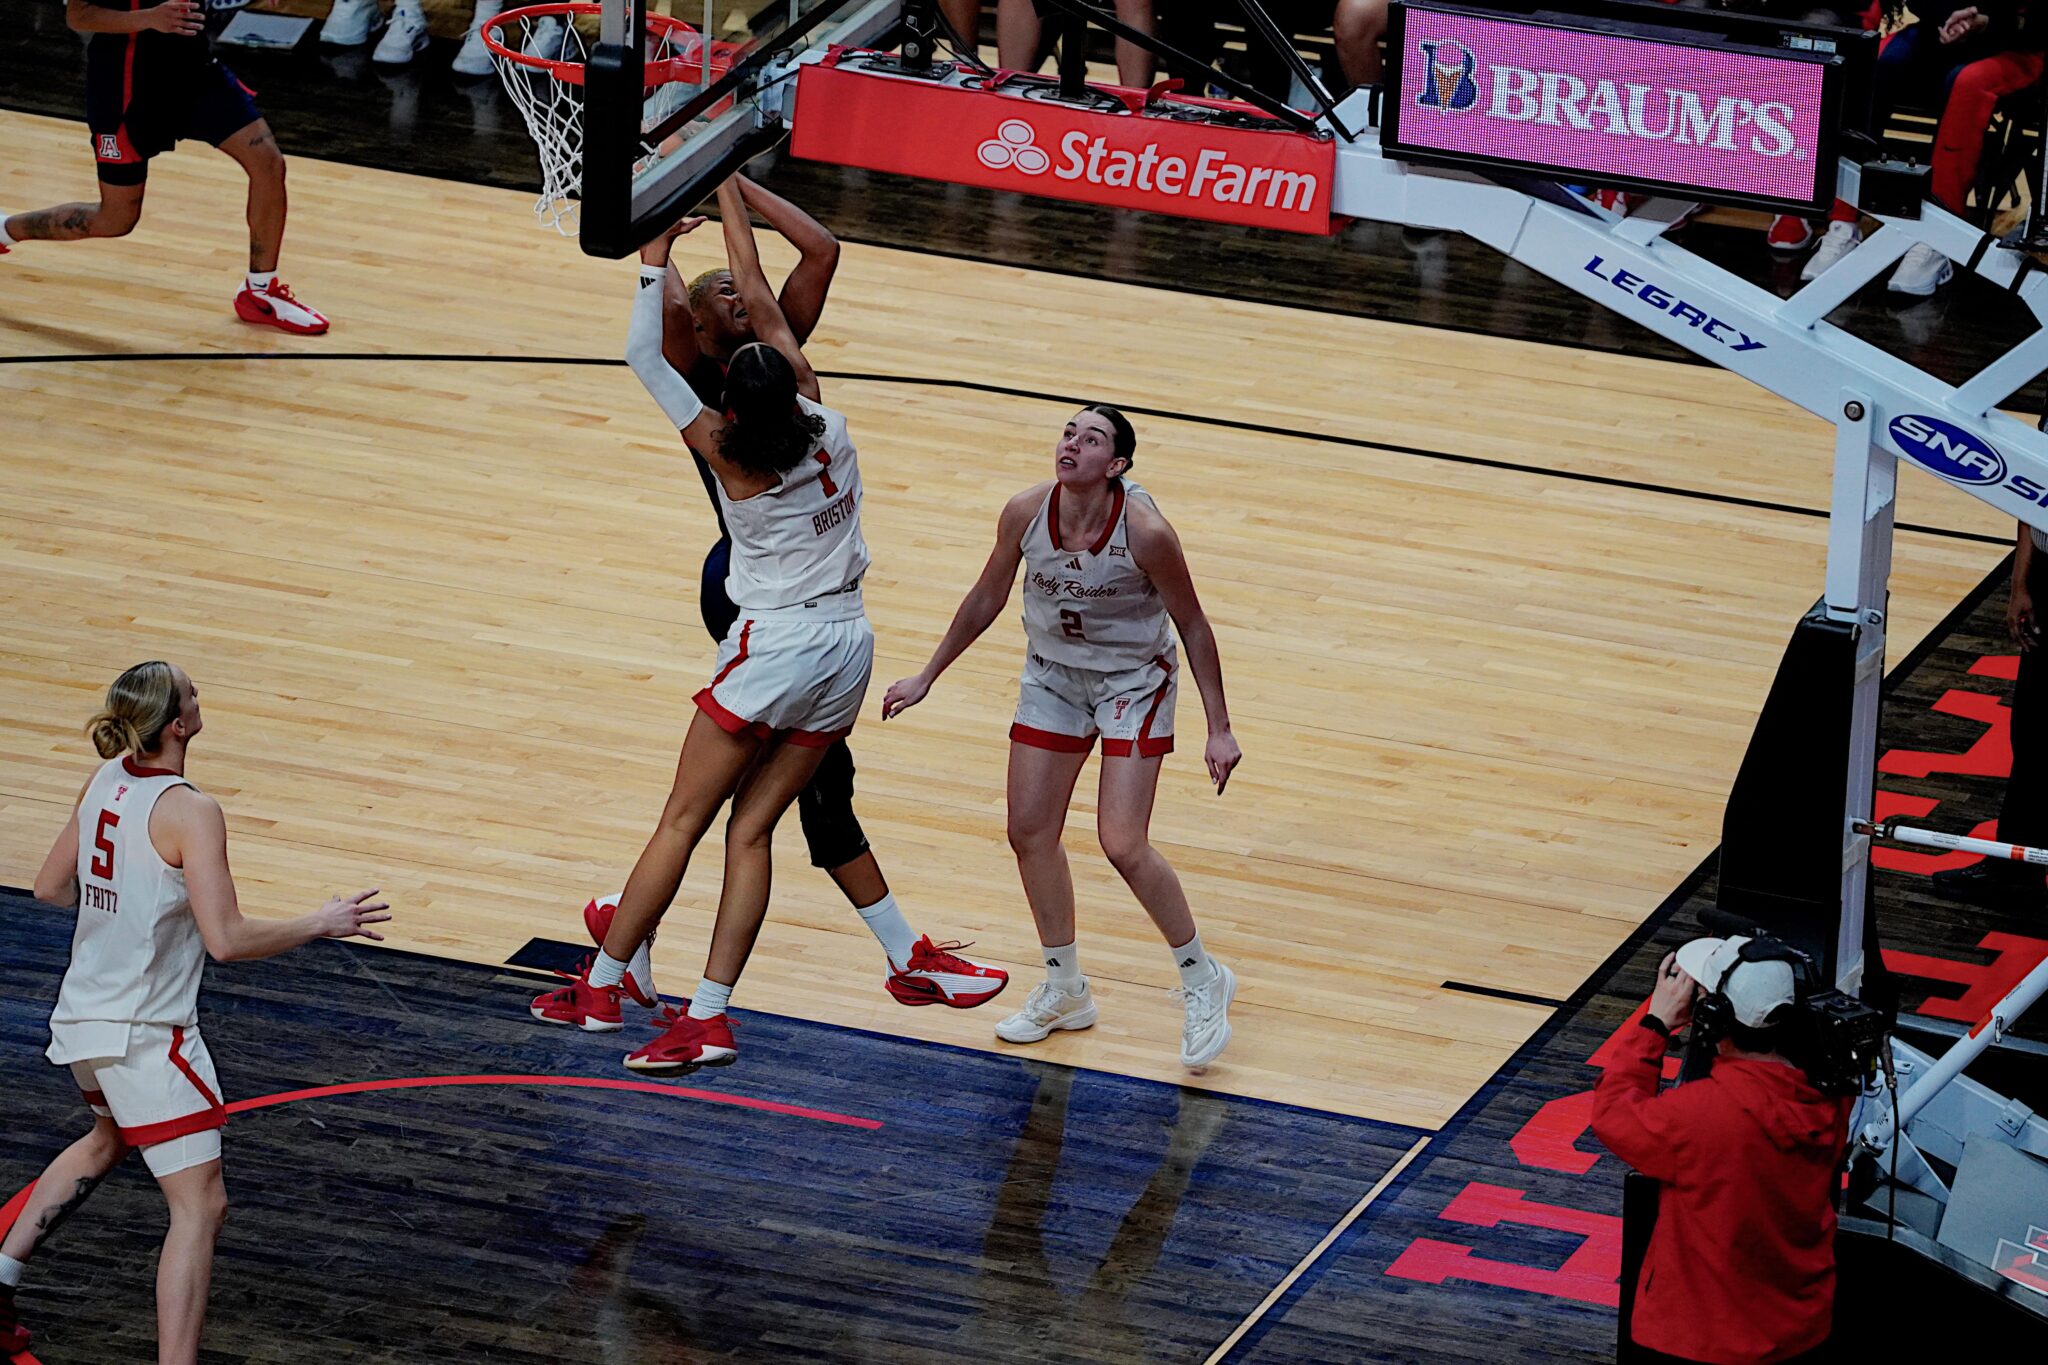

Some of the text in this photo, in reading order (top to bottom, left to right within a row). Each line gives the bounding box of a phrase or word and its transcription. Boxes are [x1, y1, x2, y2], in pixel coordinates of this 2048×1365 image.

[1486, 63, 1800, 158] BRAUM'S
[100, 134, 121, 160] A
[1584, 255, 1768, 352] LEGACY
[813, 447, 839, 499] 1
[1891, 416, 2048, 508] SNA S
[1032, 572, 1120, 599] Lady Raiders
[1060, 609, 1086, 640] 2
[91, 808, 120, 881] 5
